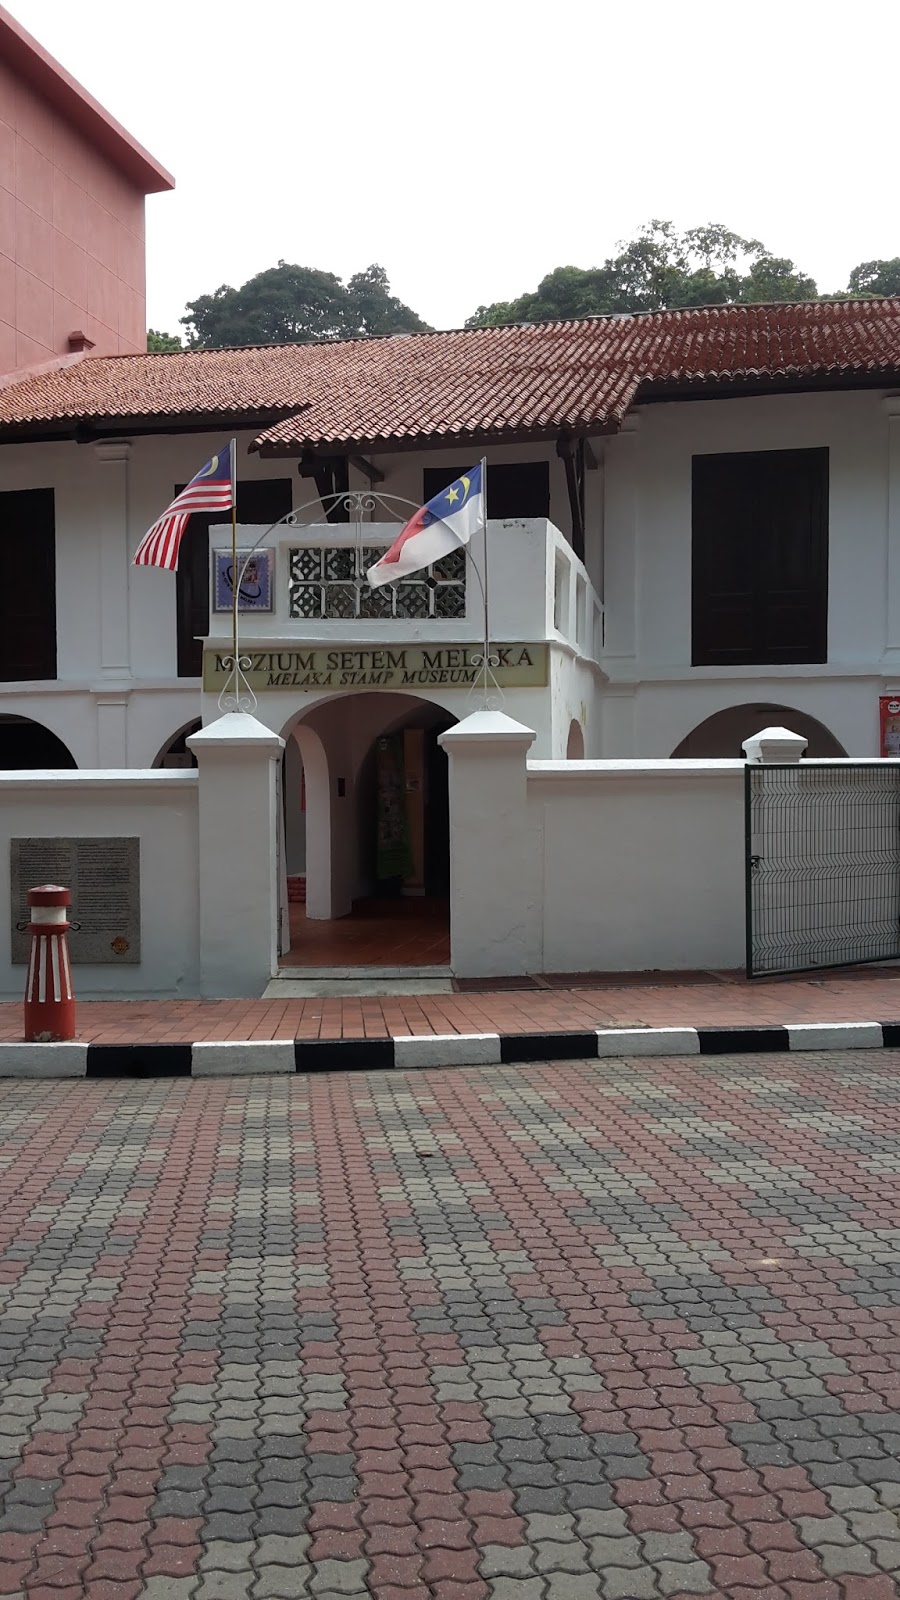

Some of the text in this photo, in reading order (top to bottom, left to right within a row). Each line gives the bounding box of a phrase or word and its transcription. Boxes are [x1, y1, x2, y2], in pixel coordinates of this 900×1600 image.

[326, 650, 408, 671] SETEM
[266, 669, 478, 686] MELAKA STAMP MUSEUM
